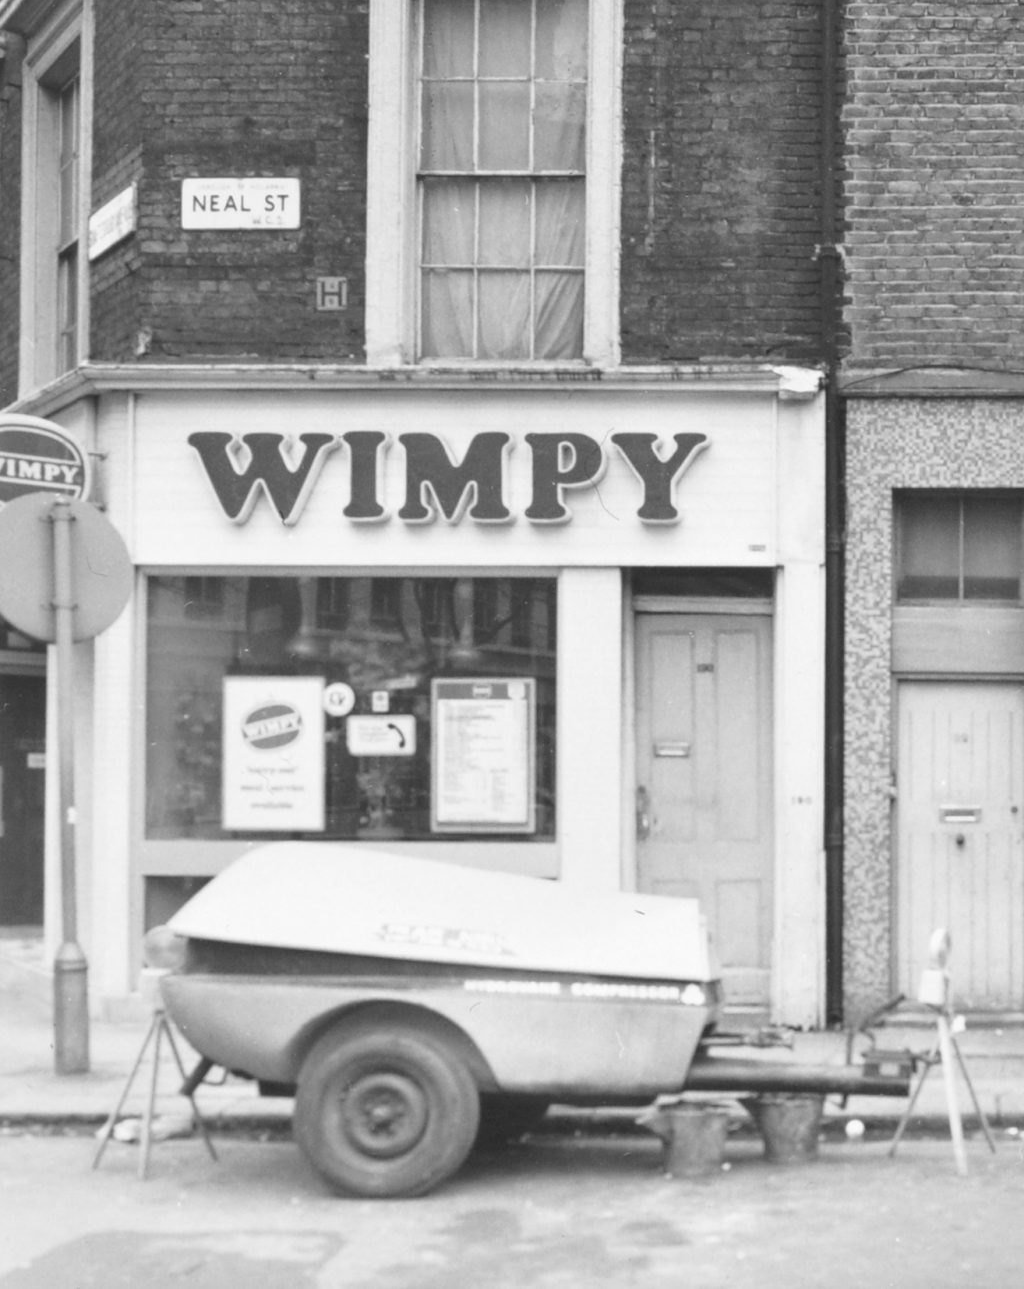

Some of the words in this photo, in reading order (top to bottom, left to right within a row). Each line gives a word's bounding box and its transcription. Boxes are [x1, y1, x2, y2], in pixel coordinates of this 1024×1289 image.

[193, 195, 251, 212] NEAL
[264, 195, 289, 212] ST
[188, 430, 708, 522] WIMPY
